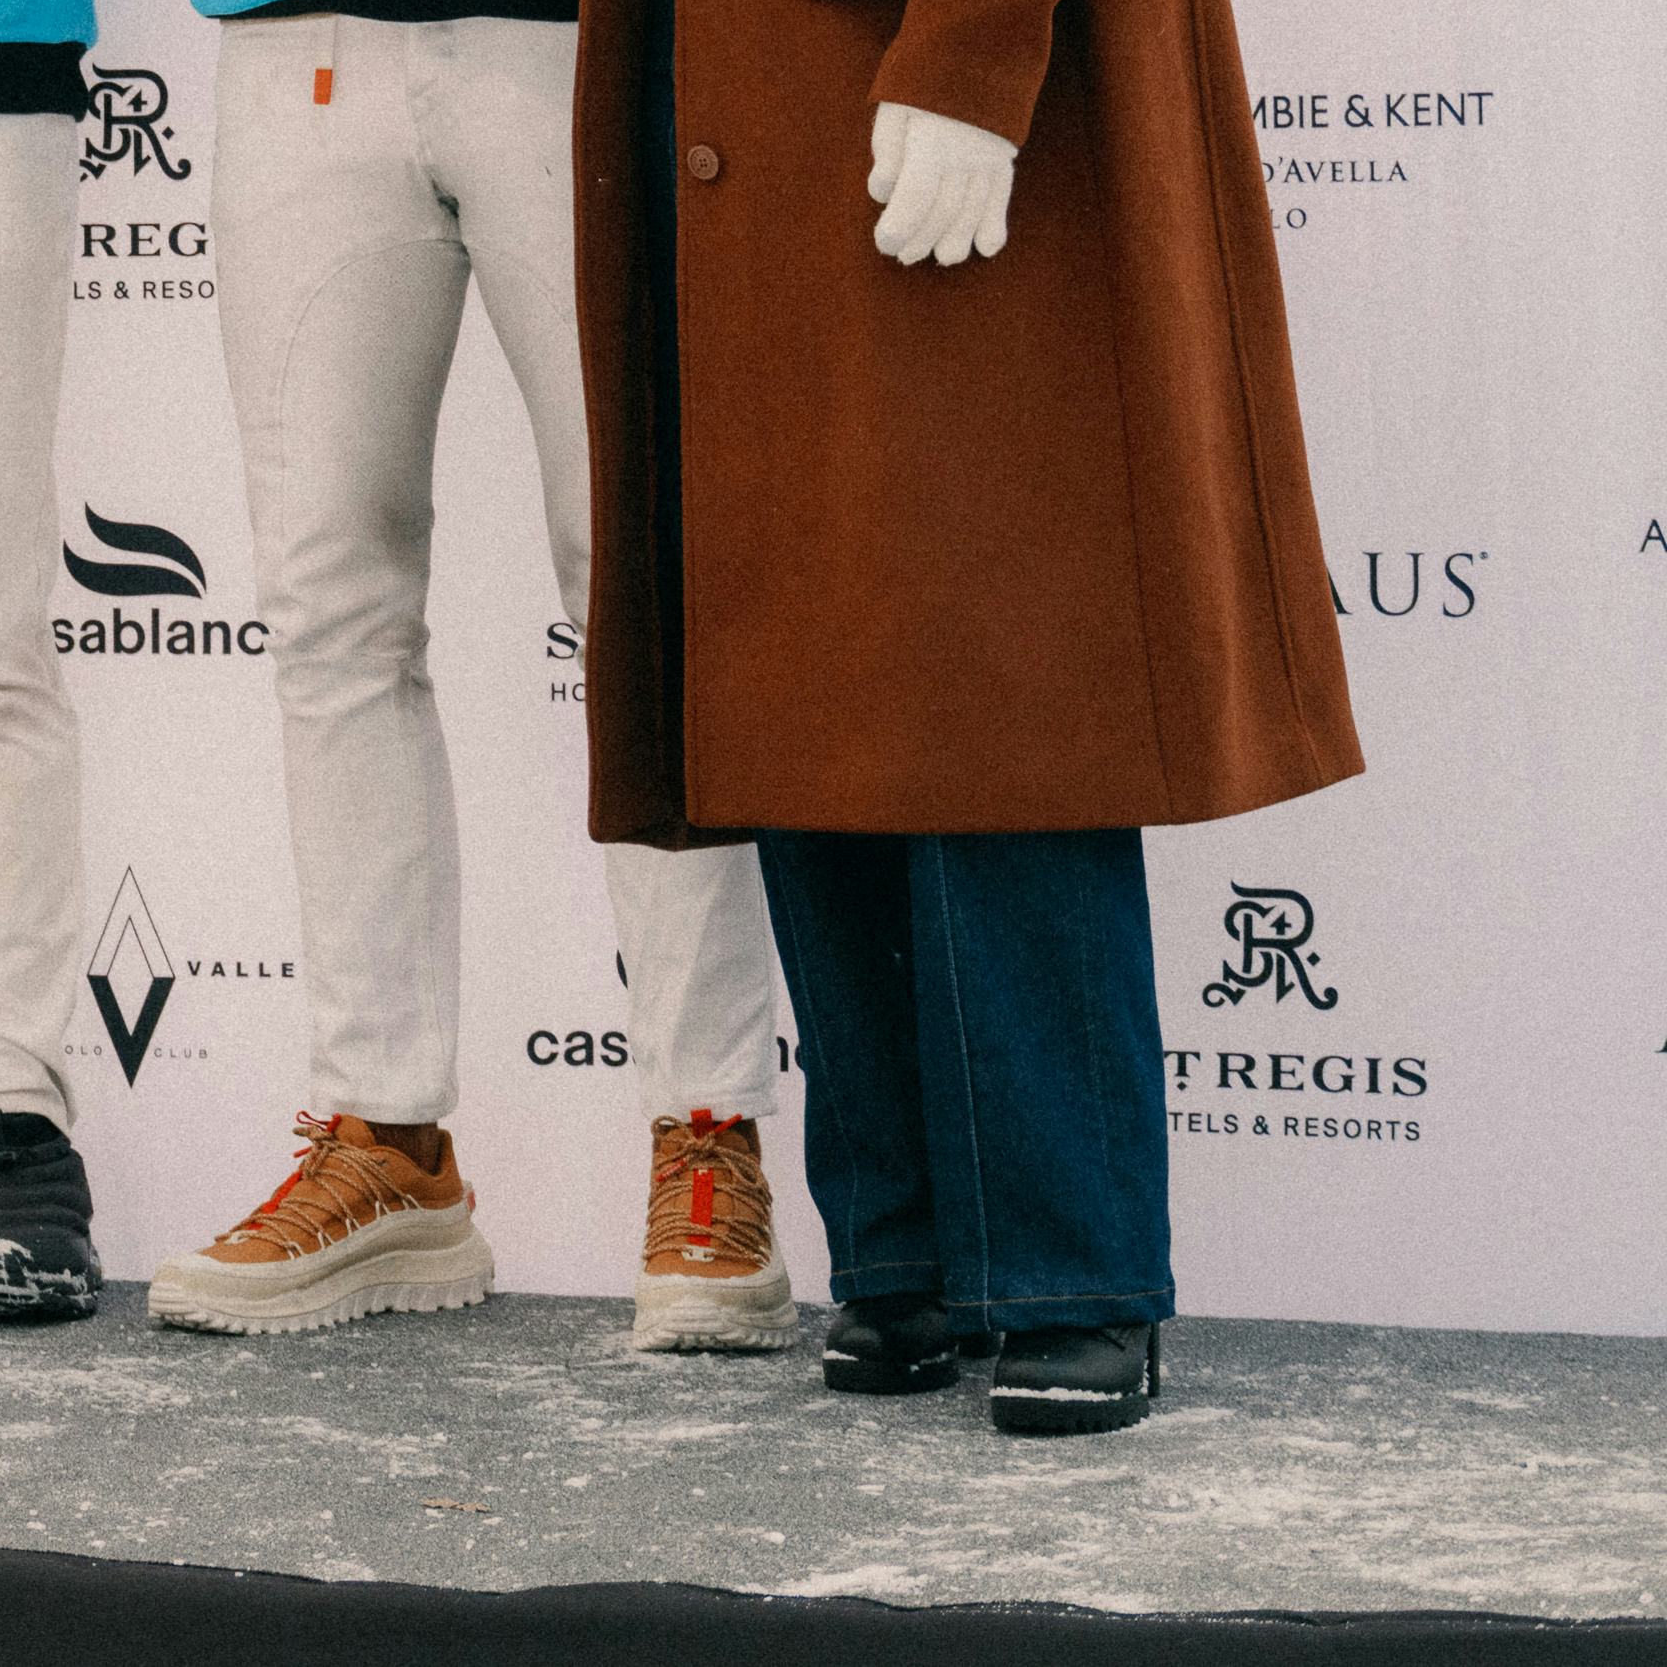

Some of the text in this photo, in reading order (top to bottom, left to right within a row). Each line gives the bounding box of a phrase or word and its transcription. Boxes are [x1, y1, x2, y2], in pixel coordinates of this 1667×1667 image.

[1344, 94, 1374, 128] &
[1386, 92, 1494, 127] KENT
[81, 222, 208, 257] REG
[113, 280, 129, 300] &
[143, 280, 215, 299] RESO
[52, 608, 270, 655] sablanc
[187, 960, 294, 978] VALLE
[64, 1045, 103, 1057] OLO
[154, 1048, 208, 1060] CLUB
[1217, 1052, 1427, 1097] REGIS
[1169, 1112, 1420, 1141] TELS & RESORTS
